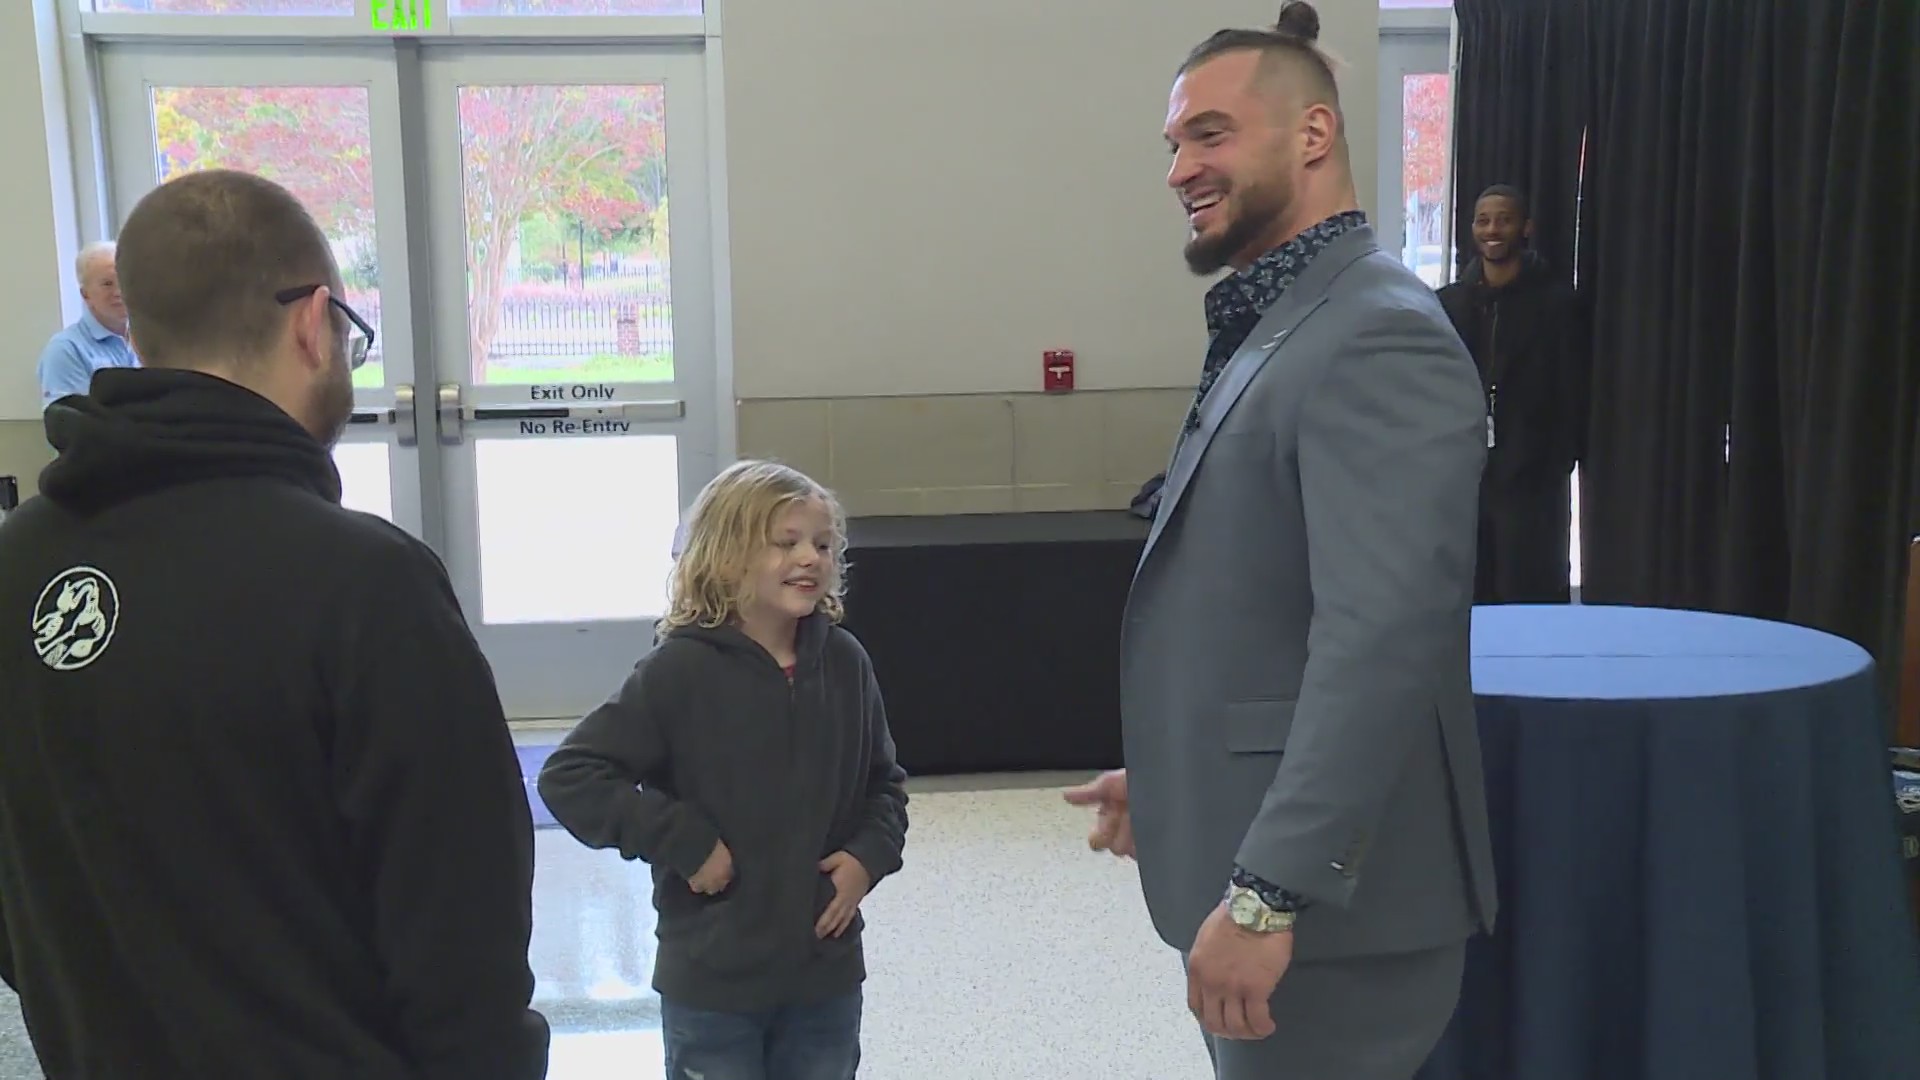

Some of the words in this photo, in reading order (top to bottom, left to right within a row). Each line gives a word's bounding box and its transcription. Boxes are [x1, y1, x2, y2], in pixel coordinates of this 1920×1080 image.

[530, 385, 564, 400] Exit
[571, 384, 615, 401] Only
[520, 421, 546, 434] No
[552, 420, 631, 435] Re-Entry
